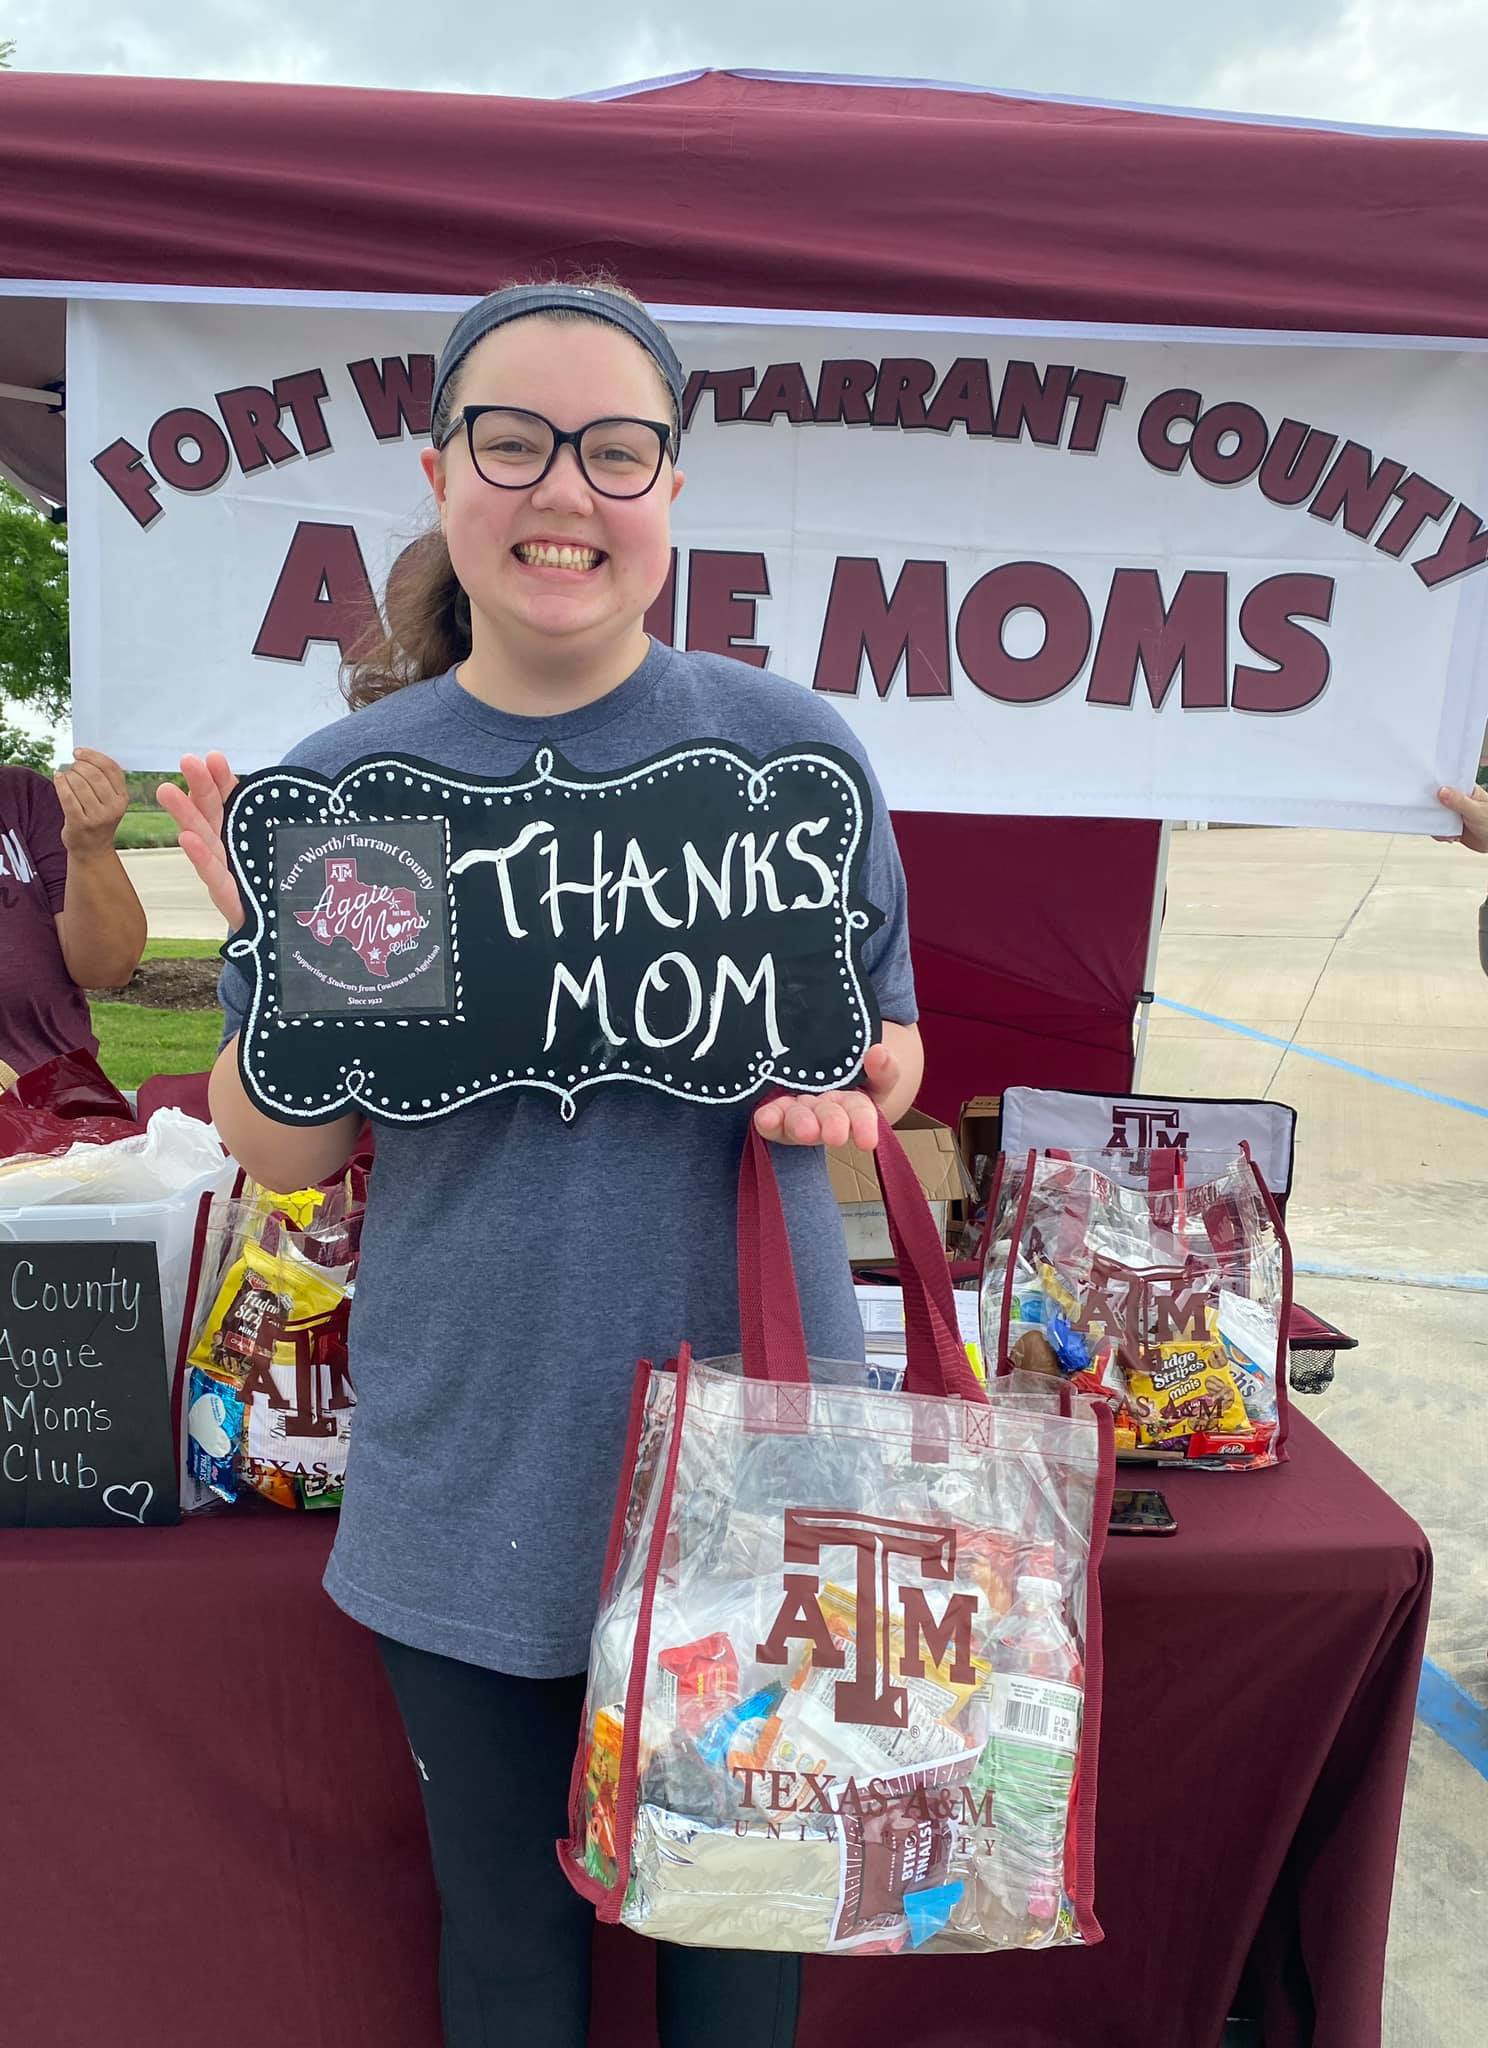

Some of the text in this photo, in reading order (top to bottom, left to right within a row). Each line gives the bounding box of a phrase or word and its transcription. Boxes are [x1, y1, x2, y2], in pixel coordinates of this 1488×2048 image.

[91, 354, 1488, 590] FORT W/TARRANT COUNTY
[812, 556, 1336, 714] MOMS
[280, 863, 304, 892] Fort
[398, 850, 435, 891] County
[450, 817, 835, 940] THANKS
[297, 884, 393, 935] Aggie
[389, 934, 419, 956] Club
[292, 950, 328, 983] Supporting
[326, 976, 358, 992] Students
[357, 983, 377, 993] from
[377, 976, 409, 991] Cowtown
[347, 997, 366, 1005] Since
[543, 952, 789, 1061] MOM
[11, 1260, 141, 1332] County
[0, 1328, 103, 1388] Aggie
[1153, 1359, 1205, 1390] Stripes
[3, 1390, 112, 1435] Mom's
[1169, 1378, 1200, 1401] minis
[3, 1443, 98, 1489] Club
[732, 1767, 996, 1828] TEXAS A&M
[914, 1820, 932, 1883] FINALS!
